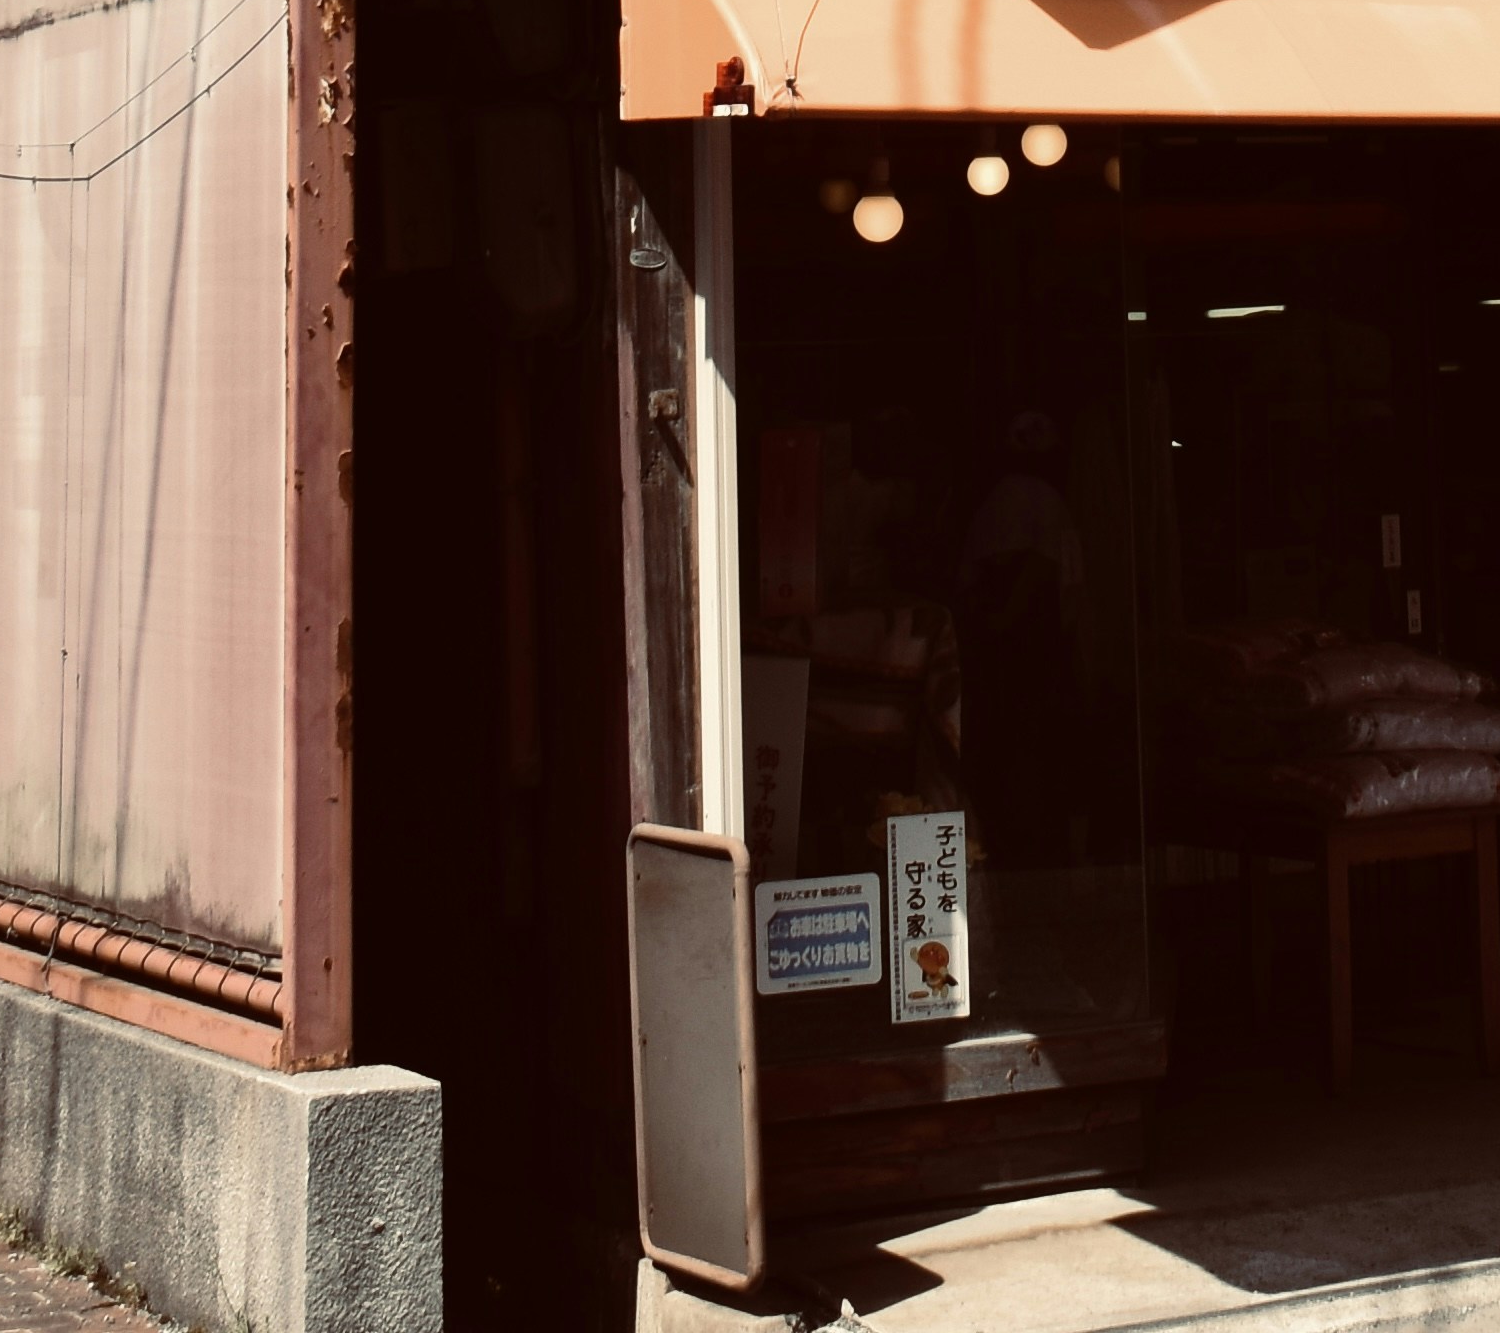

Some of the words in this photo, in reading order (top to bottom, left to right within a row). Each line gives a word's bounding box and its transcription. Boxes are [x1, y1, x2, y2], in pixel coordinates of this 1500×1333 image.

[905, 860, 927, 938] 守る家
[936, 824, 958, 913] 子どもを
